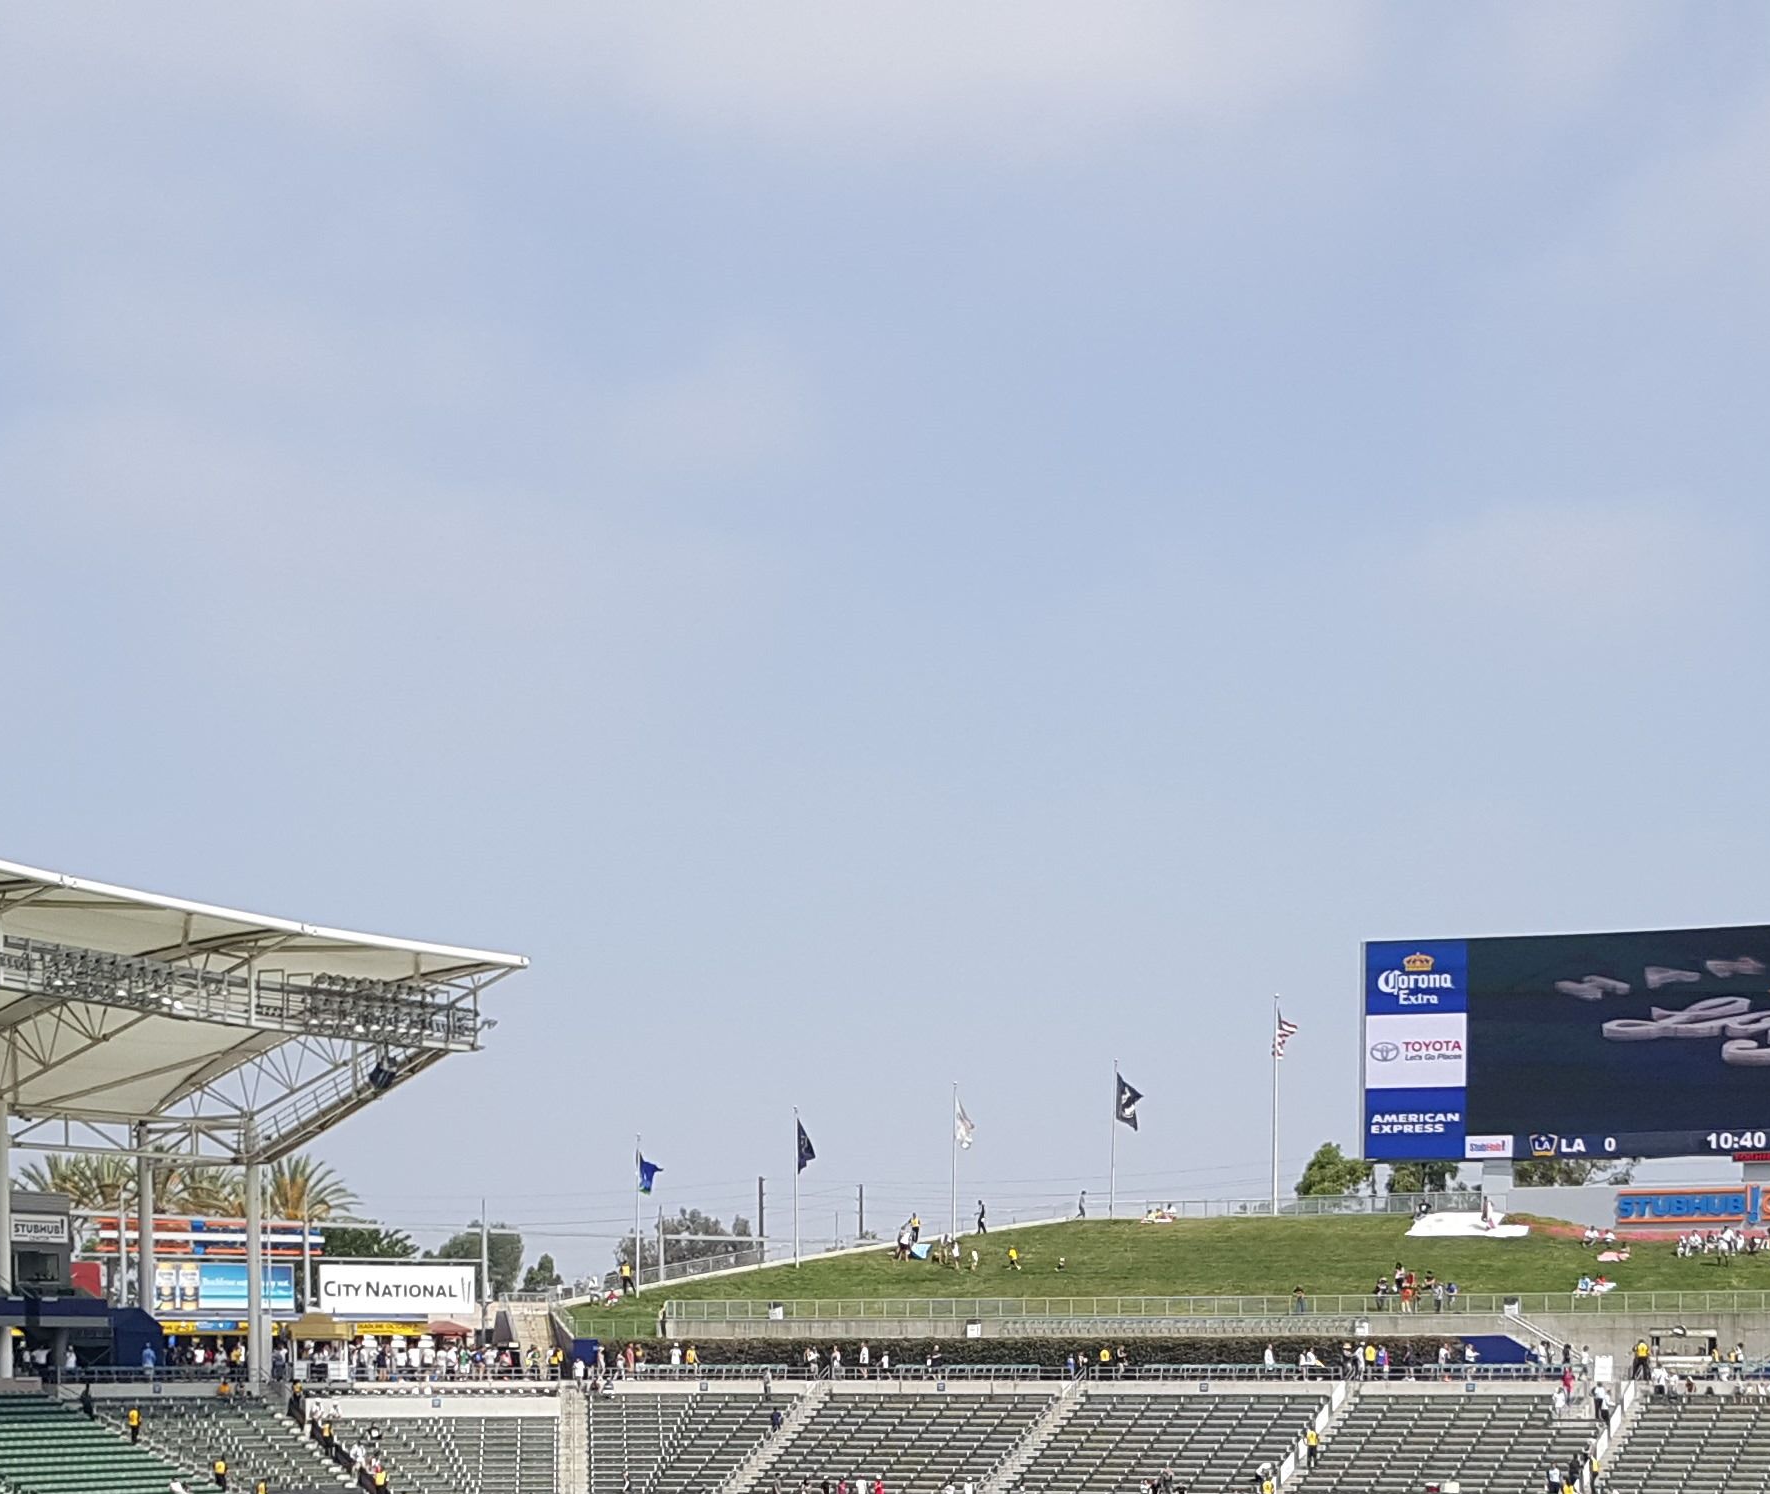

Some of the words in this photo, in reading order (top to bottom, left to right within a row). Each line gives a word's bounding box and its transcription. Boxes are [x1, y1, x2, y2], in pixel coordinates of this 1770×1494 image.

[1378, 969, 1455, 995] Corona
[1399, 990, 1438, 1005] Extra
[1403, 1041, 1462, 1052] TOYOTA
[1405, 1053, 1422, 1061] Let's
[1424, 1053, 1435, 1061] Go
[1372, 1113, 1459, 1123] AMERICAN
[1371, 1124, 1444, 1134] EXPRESS
[1561, 1138, 1586, 1152] LA
[1604, 1137, 1616, 1151] 0
[1707, 1131, 1766, 1149] 10:40
[1618, 1183, 1760, 1224] STUBHUB!
[14, 1219, 64, 1235] STUBHUB!
[324, 1281, 363, 1298] CITY
[366, 1281, 457, 1298] NATIONAL
